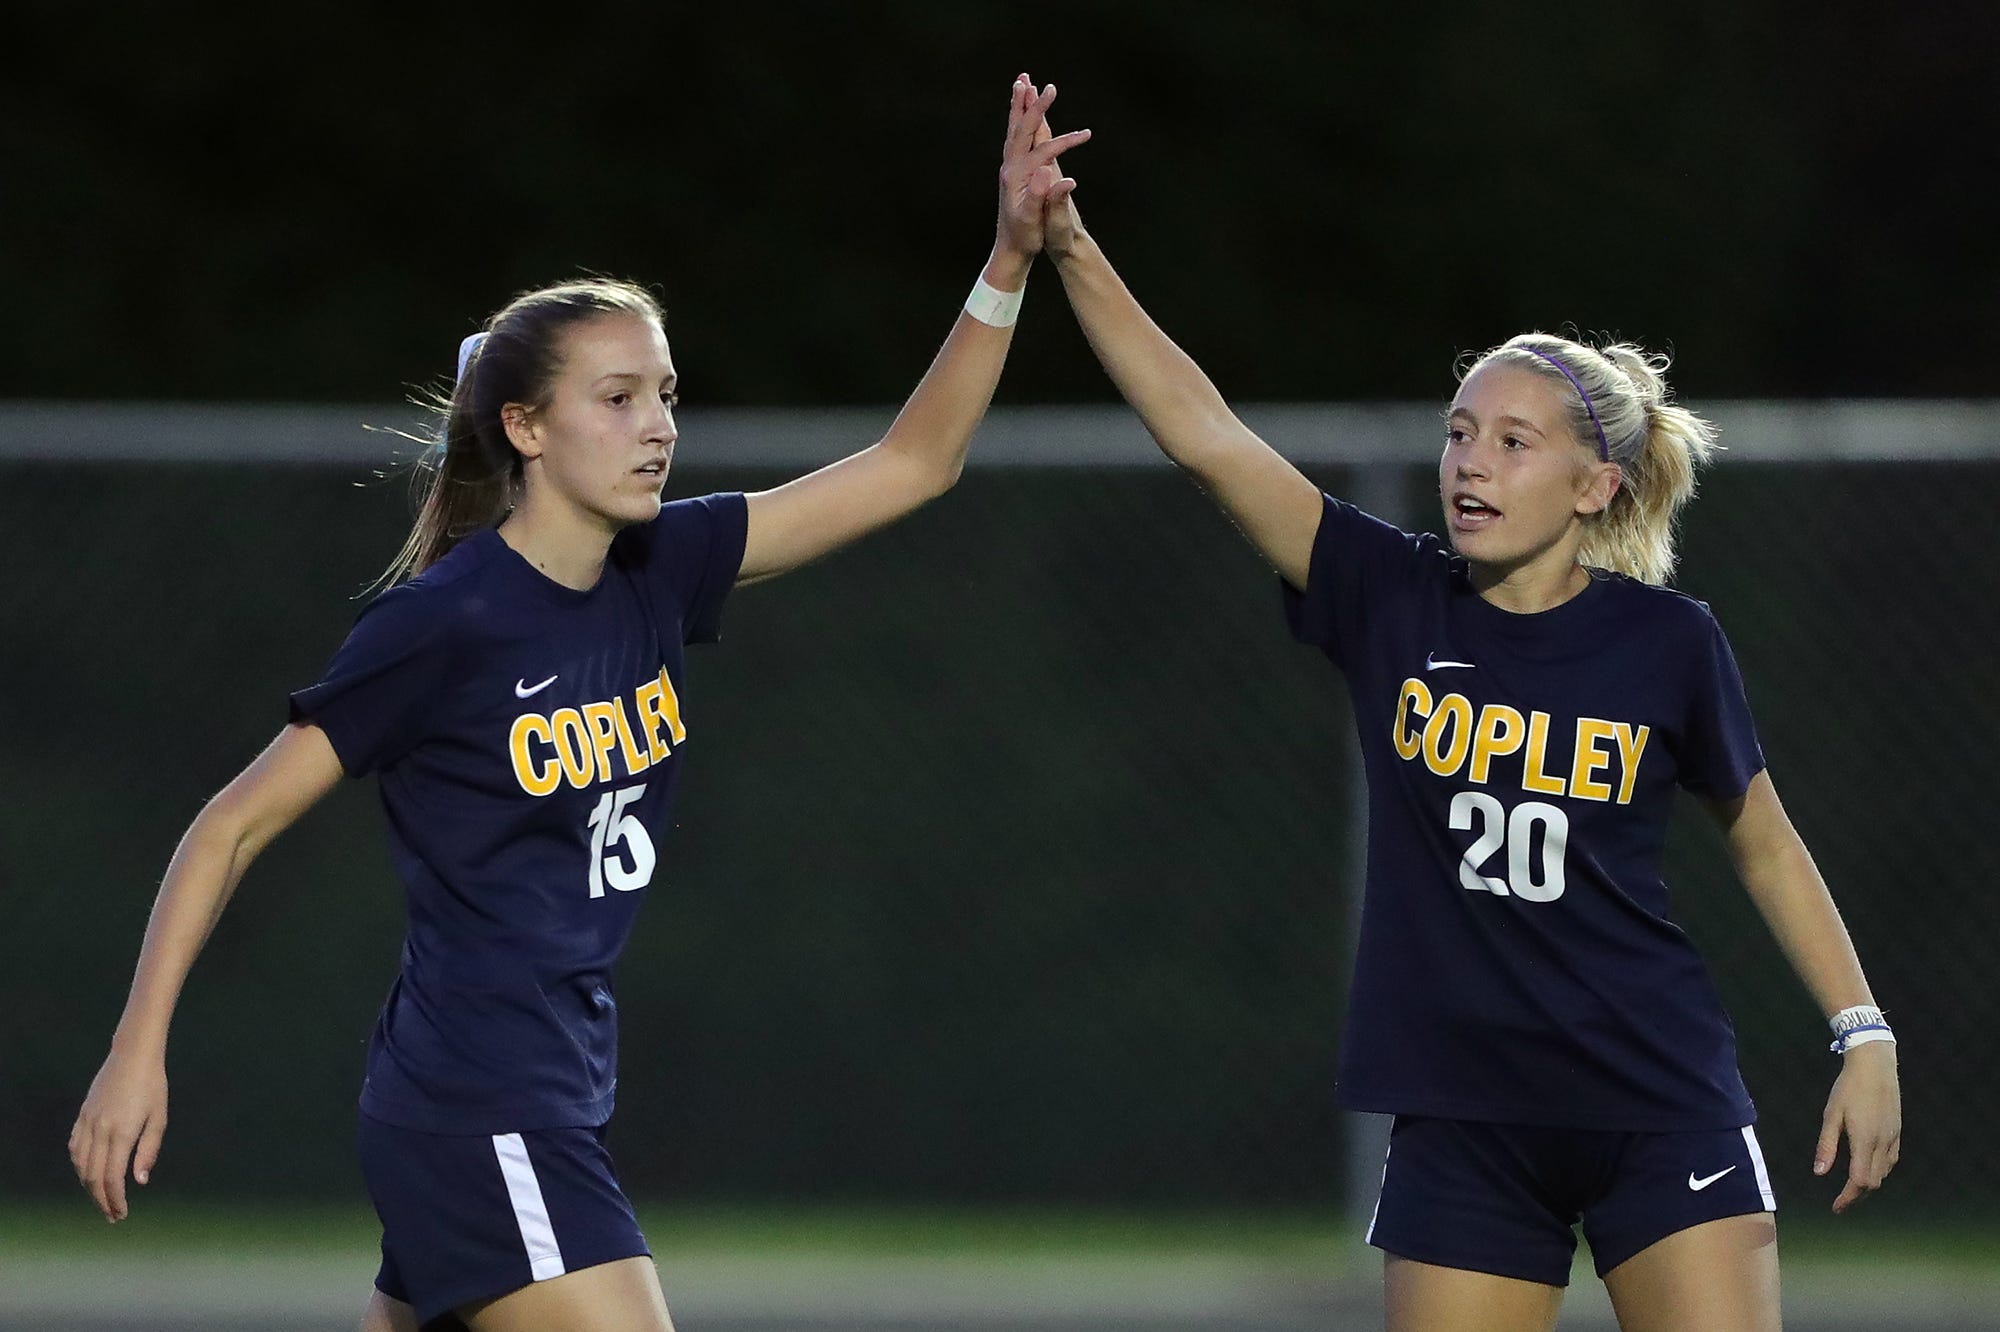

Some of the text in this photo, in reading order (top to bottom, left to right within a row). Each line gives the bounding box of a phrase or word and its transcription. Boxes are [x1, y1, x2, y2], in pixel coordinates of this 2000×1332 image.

[1393, 678, 1650, 804] COPLEY
[588, 783, 656, 898] 15
[1449, 791, 1568, 902] 20
